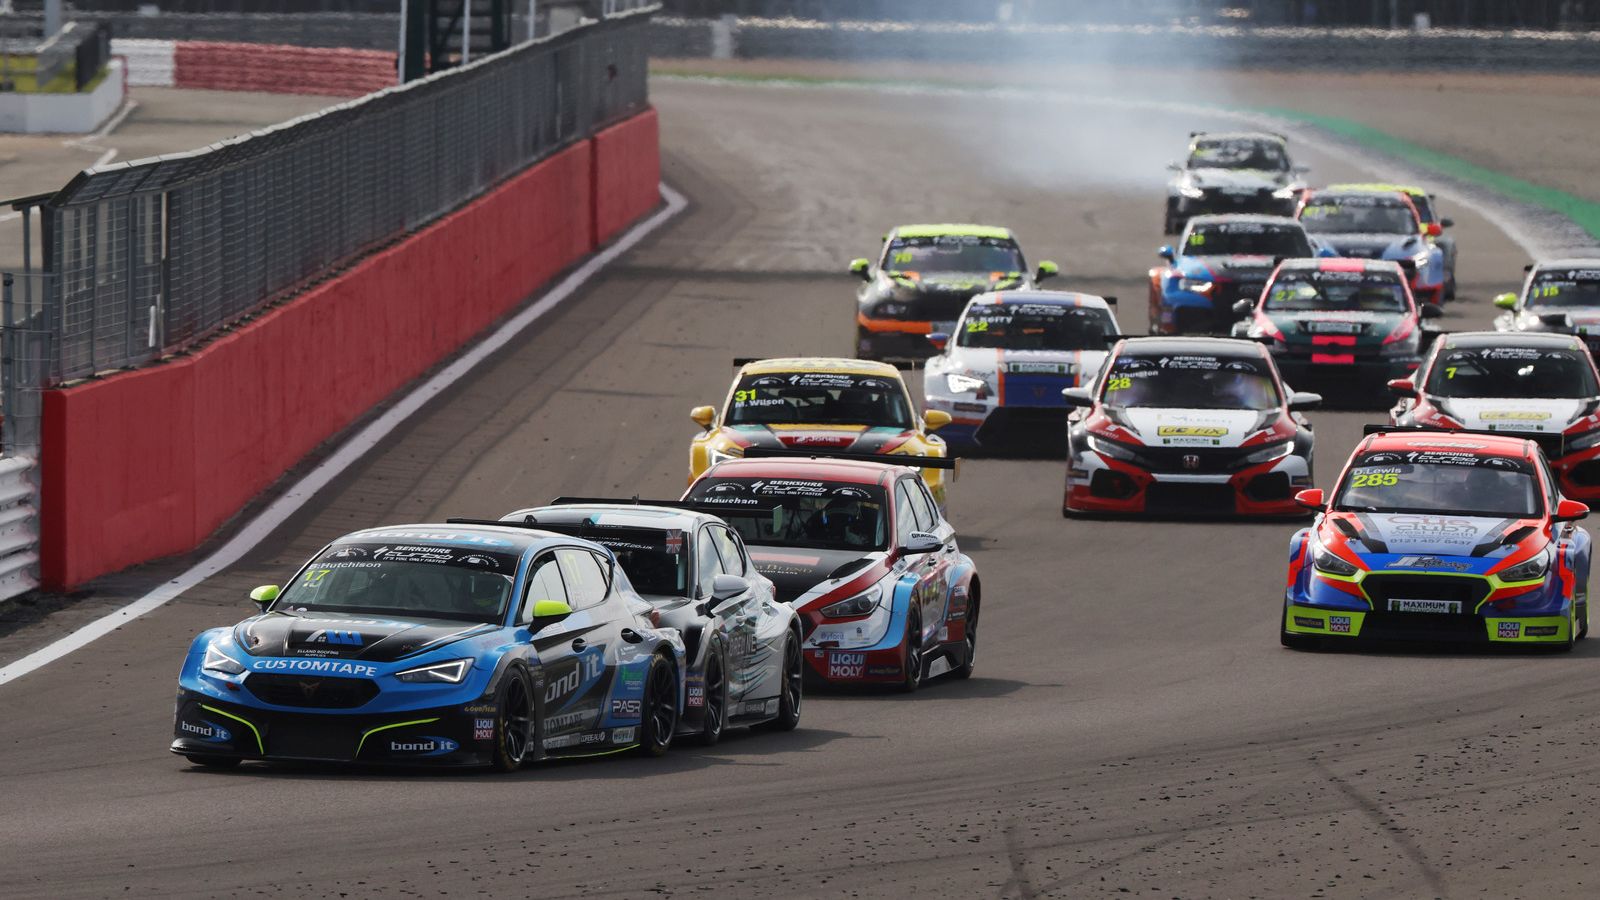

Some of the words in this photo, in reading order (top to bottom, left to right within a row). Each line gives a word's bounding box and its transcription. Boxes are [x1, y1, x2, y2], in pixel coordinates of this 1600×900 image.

[966, 321, 989, 333] 22
[1445, 367, 1457, 379] 7
[1107, 378, 1131, 391] 28
[735, 388, 757, 401] 31
[749, 398, 785, 407] Wilson
[1352, 474, 1399, 488] 285
[394, 546, 452, 554] BERKSHIRE
[304, 569, 331, 581] 17
[1403, 601, 1446, 609] MAXIMUM
[1330, 624, 1350, 632] MOLY
[1499, 622, 1520, 630] LIQUI
[1498, 630, 1520, 638] MOLY
[831, 654, 865, 665] LIQUI
[253, 660, 377, 677] CUSTOMTAPE
[830, 665, 863, 677] MOLY
[544, 661, 579, 704] ond
[584, 653, 601, 681] it
[689, 687, 703, 696] LIQUI
[612, 700, 641, 713] PASR
[689, 697, 703, 705] MOLY
[181, 720, 212, 736] bond
[215, 728, 228, 740] it
[476, 720, 494, 729] LIQUI
[475, 729, 493, 738] MOLY
[391, 741, 434, 750] bond
[440, 741, 454, 750] it
